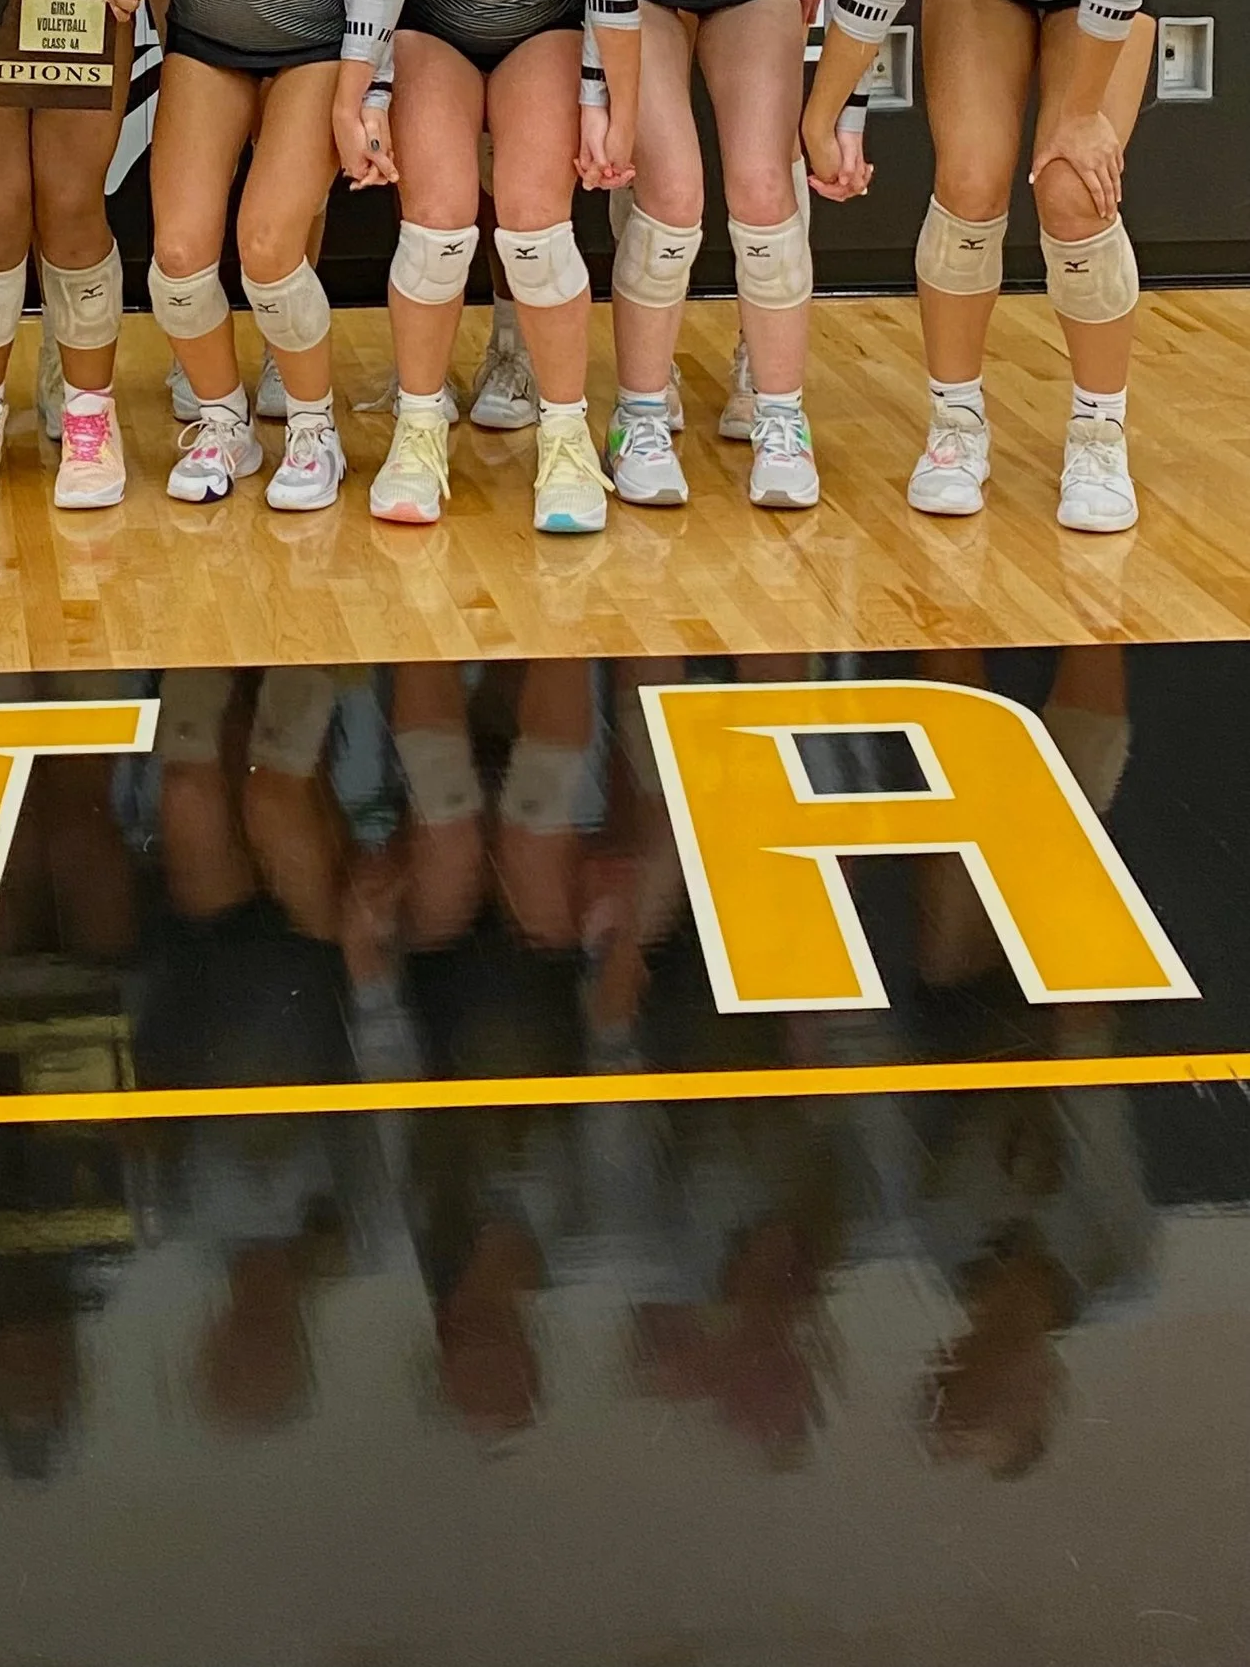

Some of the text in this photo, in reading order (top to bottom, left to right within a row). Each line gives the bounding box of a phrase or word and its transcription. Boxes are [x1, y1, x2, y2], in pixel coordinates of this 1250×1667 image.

[51, 1, 75, 15] GIRLS
[37, 17, 87, 33] VOLLEYBALL
[42, 37, 66, 50] CLASS
